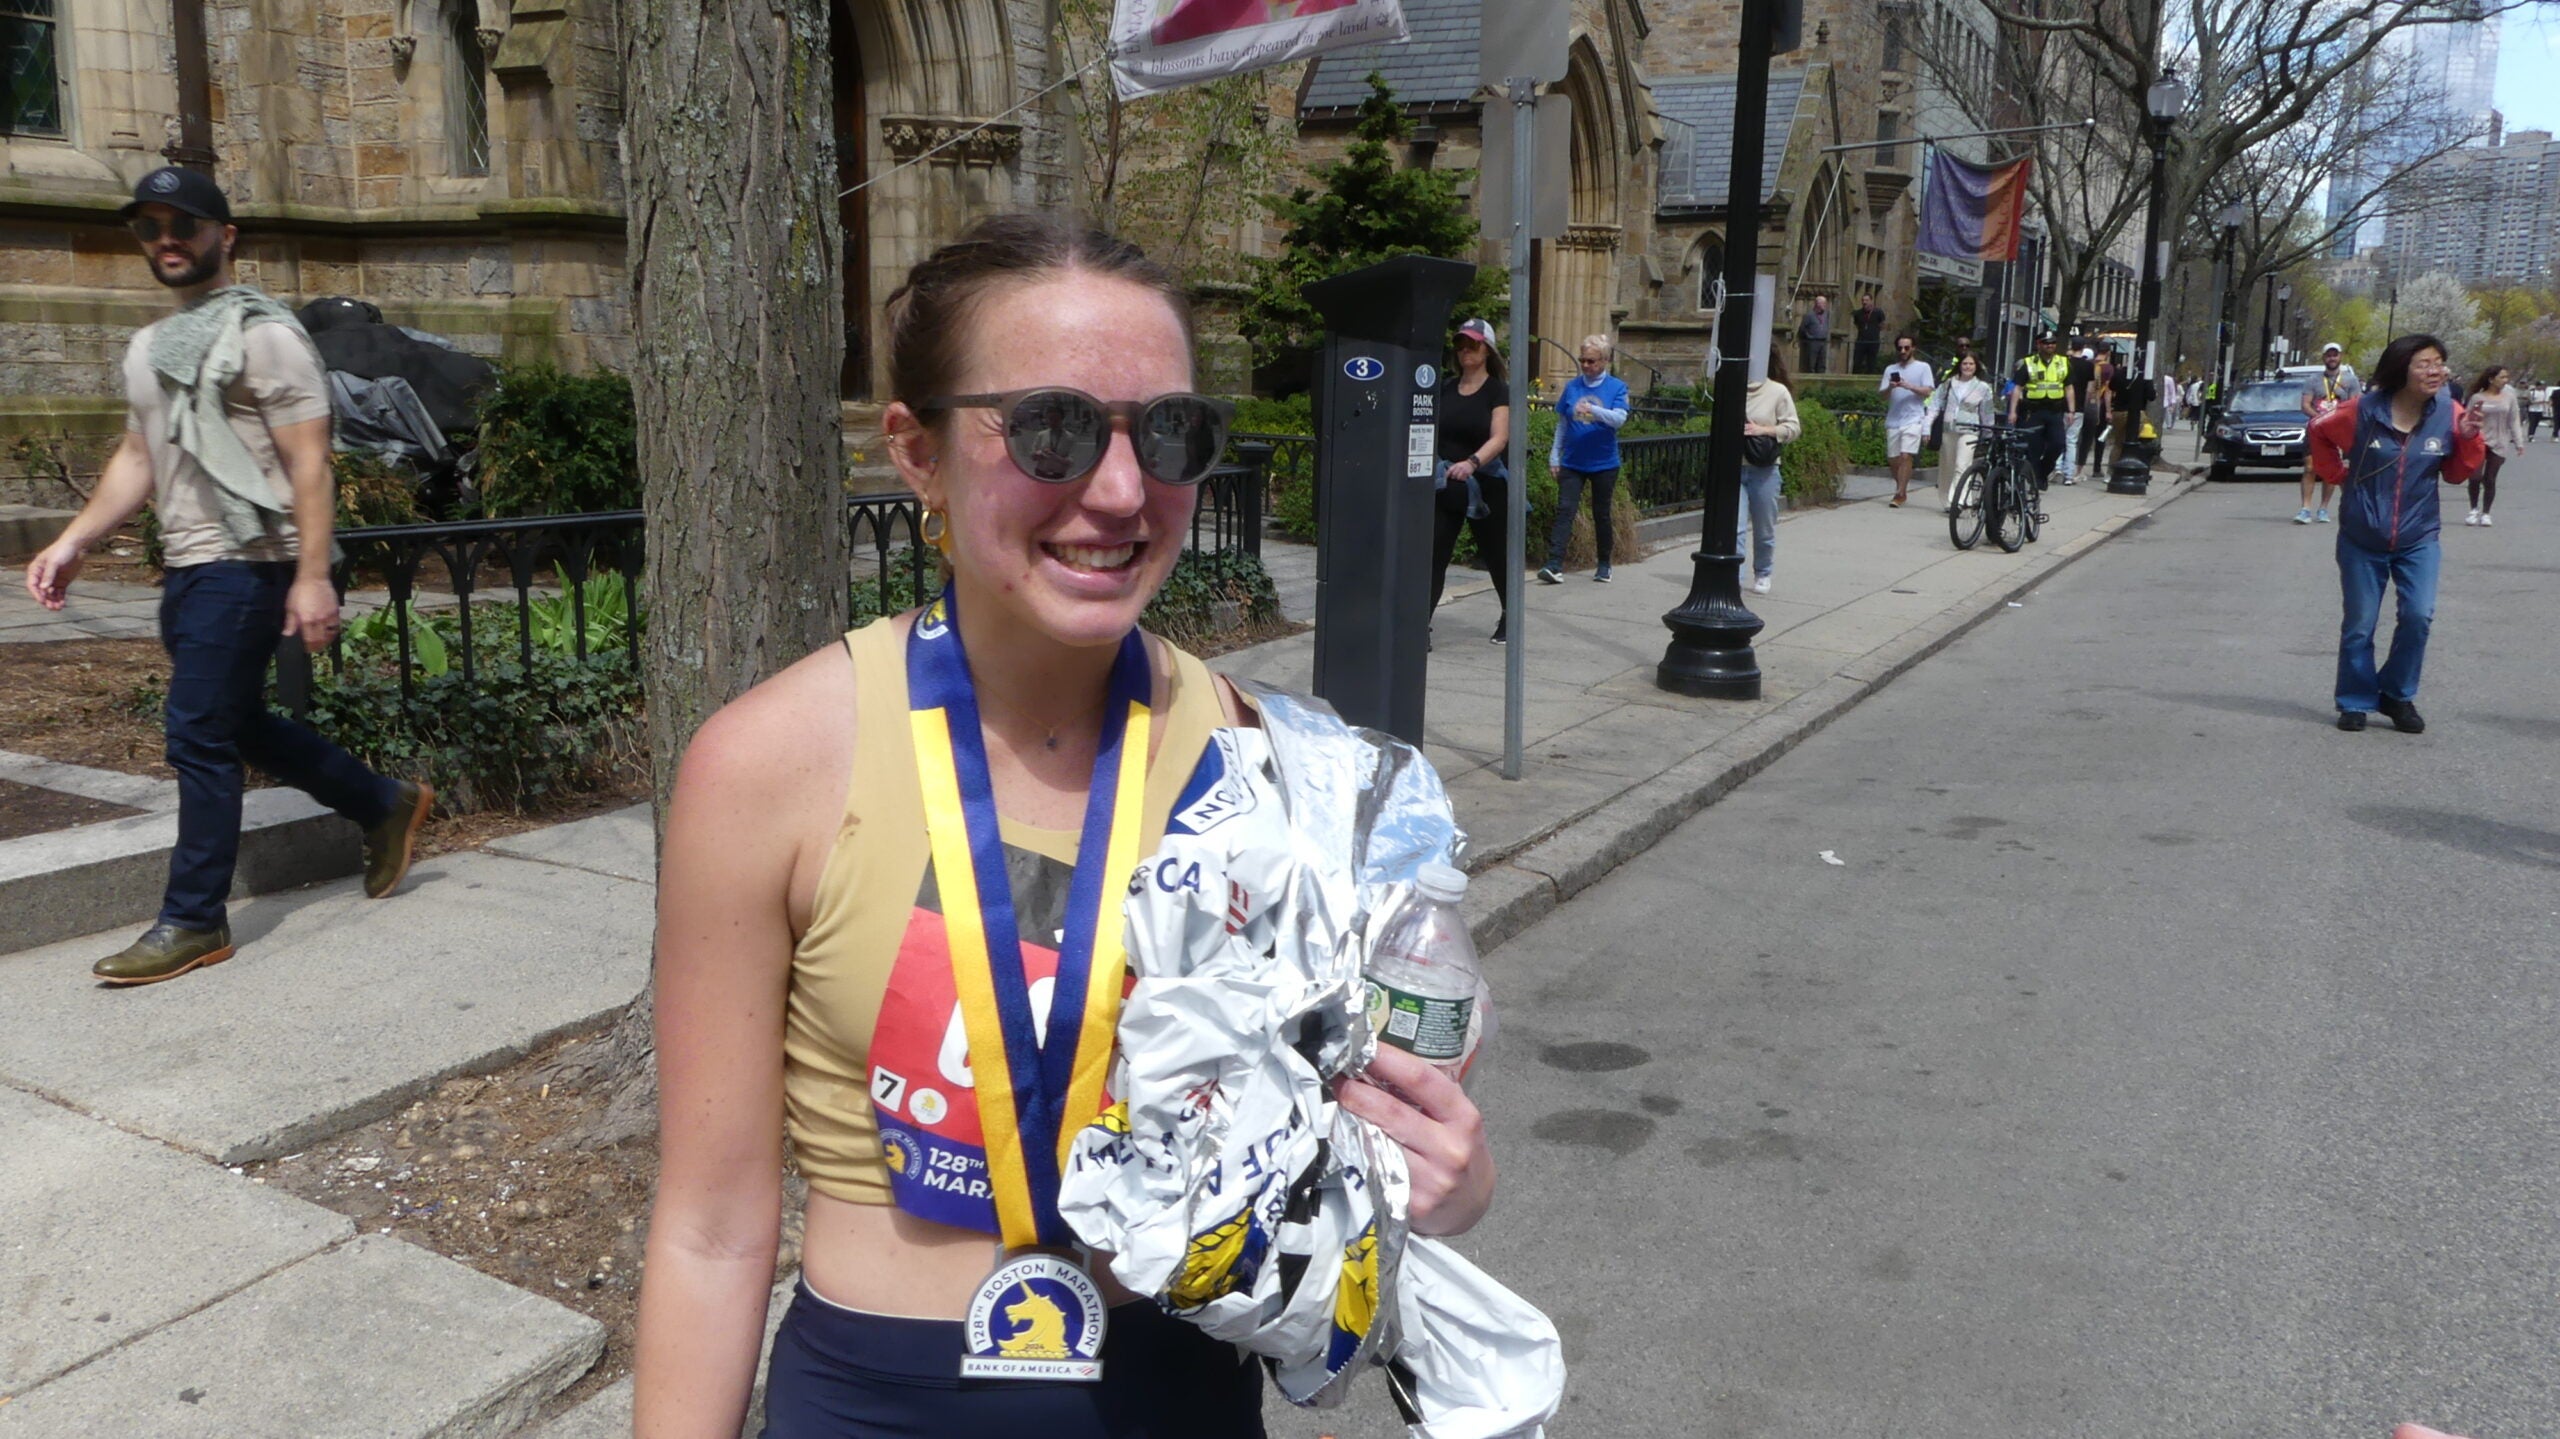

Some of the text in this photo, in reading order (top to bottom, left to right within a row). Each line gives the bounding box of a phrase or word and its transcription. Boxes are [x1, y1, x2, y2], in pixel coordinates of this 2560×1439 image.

[1151, 55, 1205, 75] blossoms
[1208, 47, 1240, 64] have
[1241, 31, 1299, 60] appeared
[1338, 16, 1368, 37] land
[1356, 359, 1369, 377] 3
[1421, 367, 1429, 384] 3
[1413, 394, 1434, 407] PARK
[1413, 407, 1434, 416] BOSTON
[879, 1073, 899, 1100] 7
[929, 1147, 985, 1173] 128TH
[923, 1169, 995, 1200] MAR
[973, 1263, 1100, 1348] 128TH BOSTON MARATHON
[967, 1363, 1072, 1375] BANK OF AMERICA
